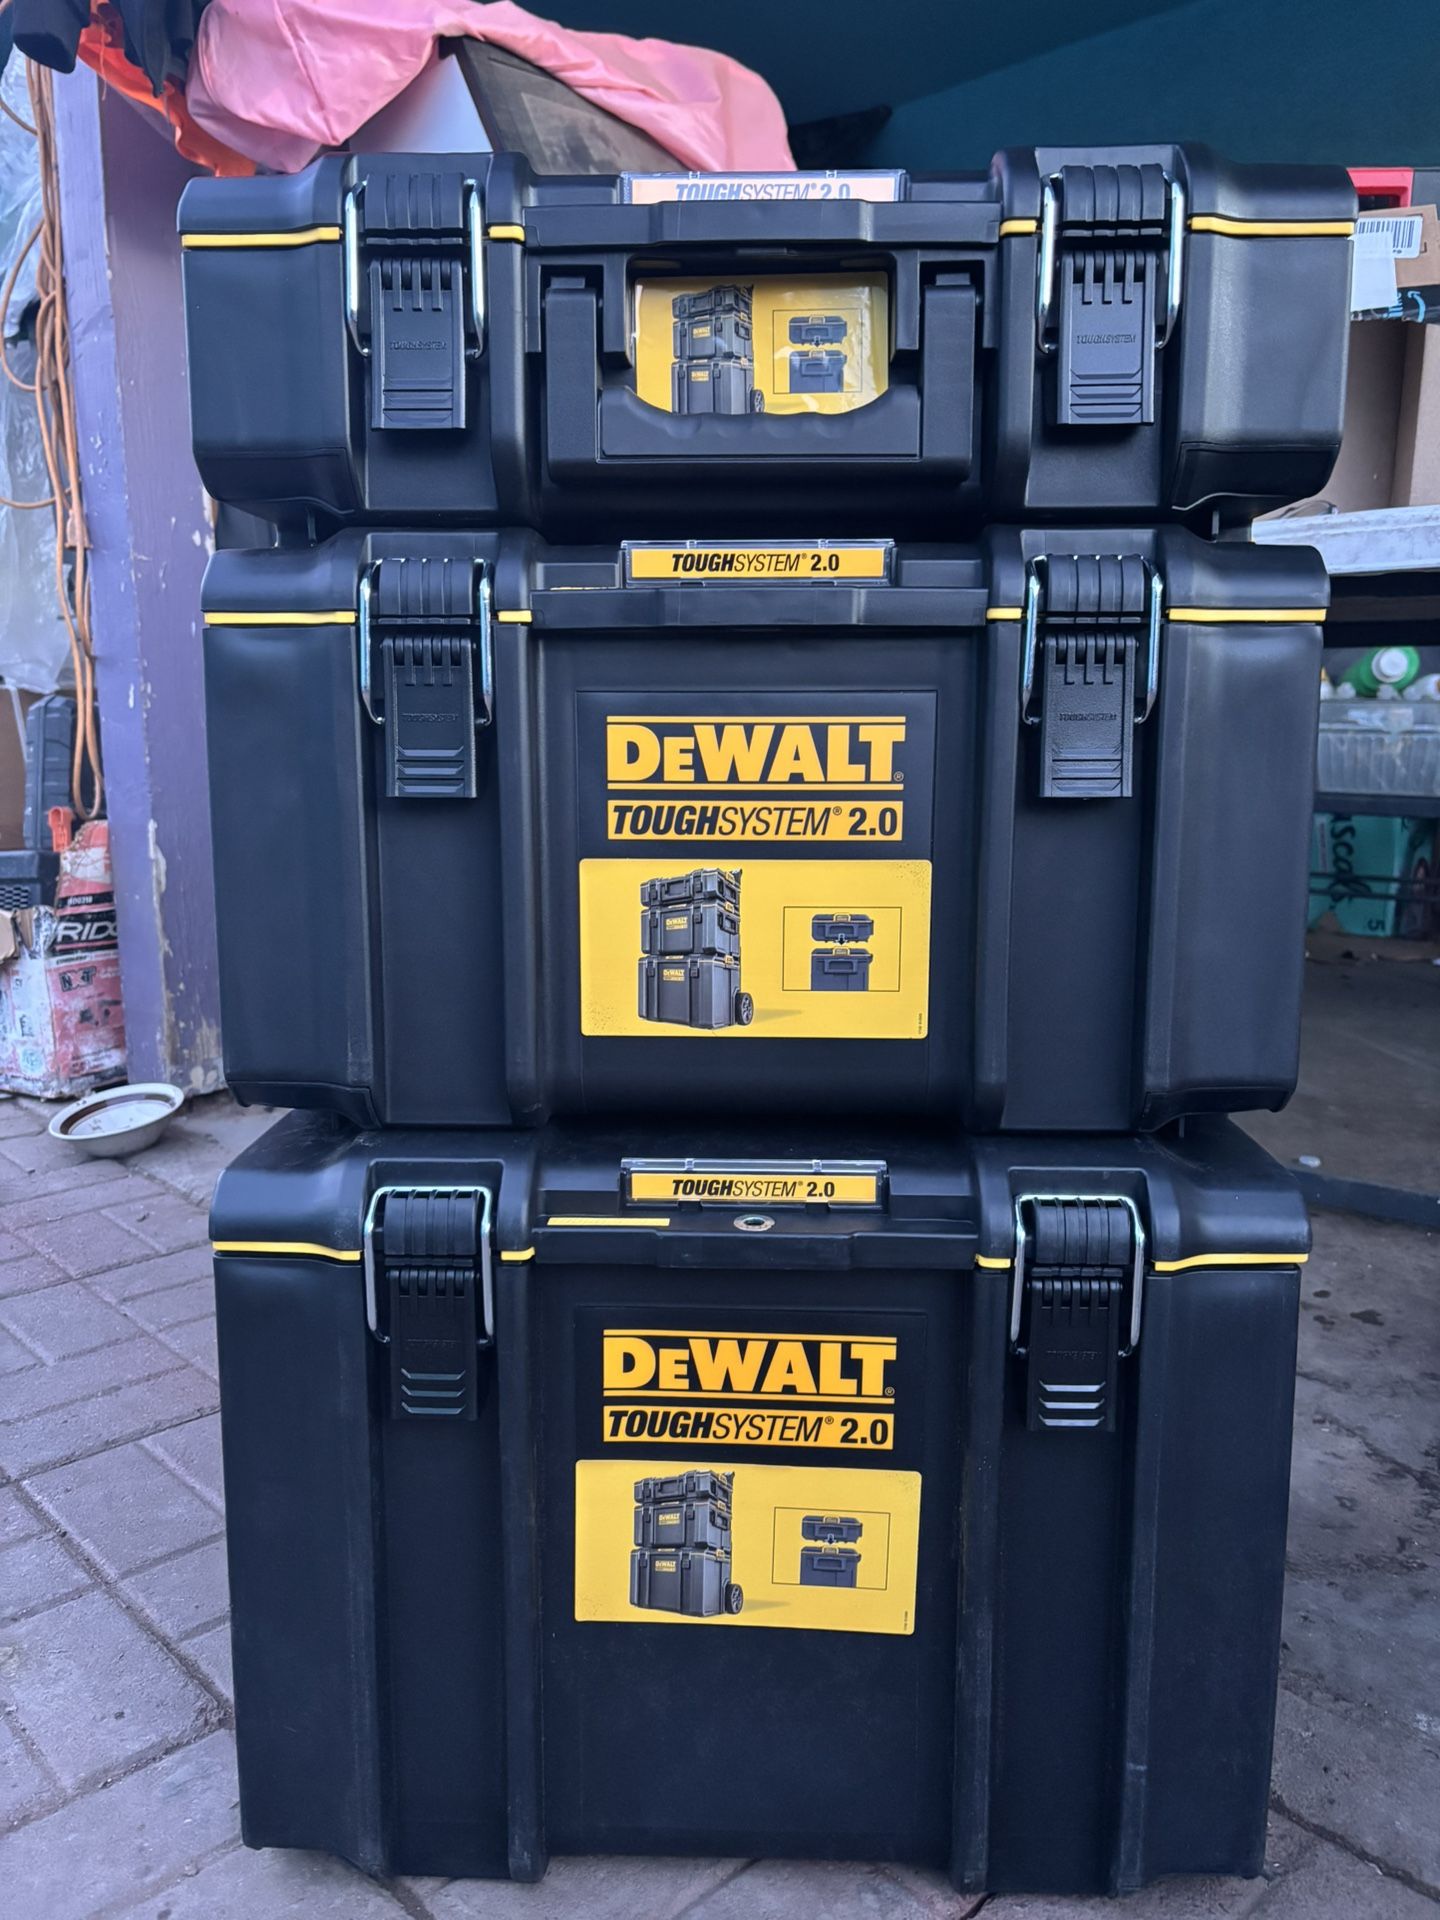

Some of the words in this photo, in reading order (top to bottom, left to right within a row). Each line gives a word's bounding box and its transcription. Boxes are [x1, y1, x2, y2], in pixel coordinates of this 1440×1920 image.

[810, 553, 839, 572] 2.0
[848, 806, 898, 836] 2.0
[806, 1180, 836, 1198] 2.0
[839, 1417, 889, 1445] 2.0
